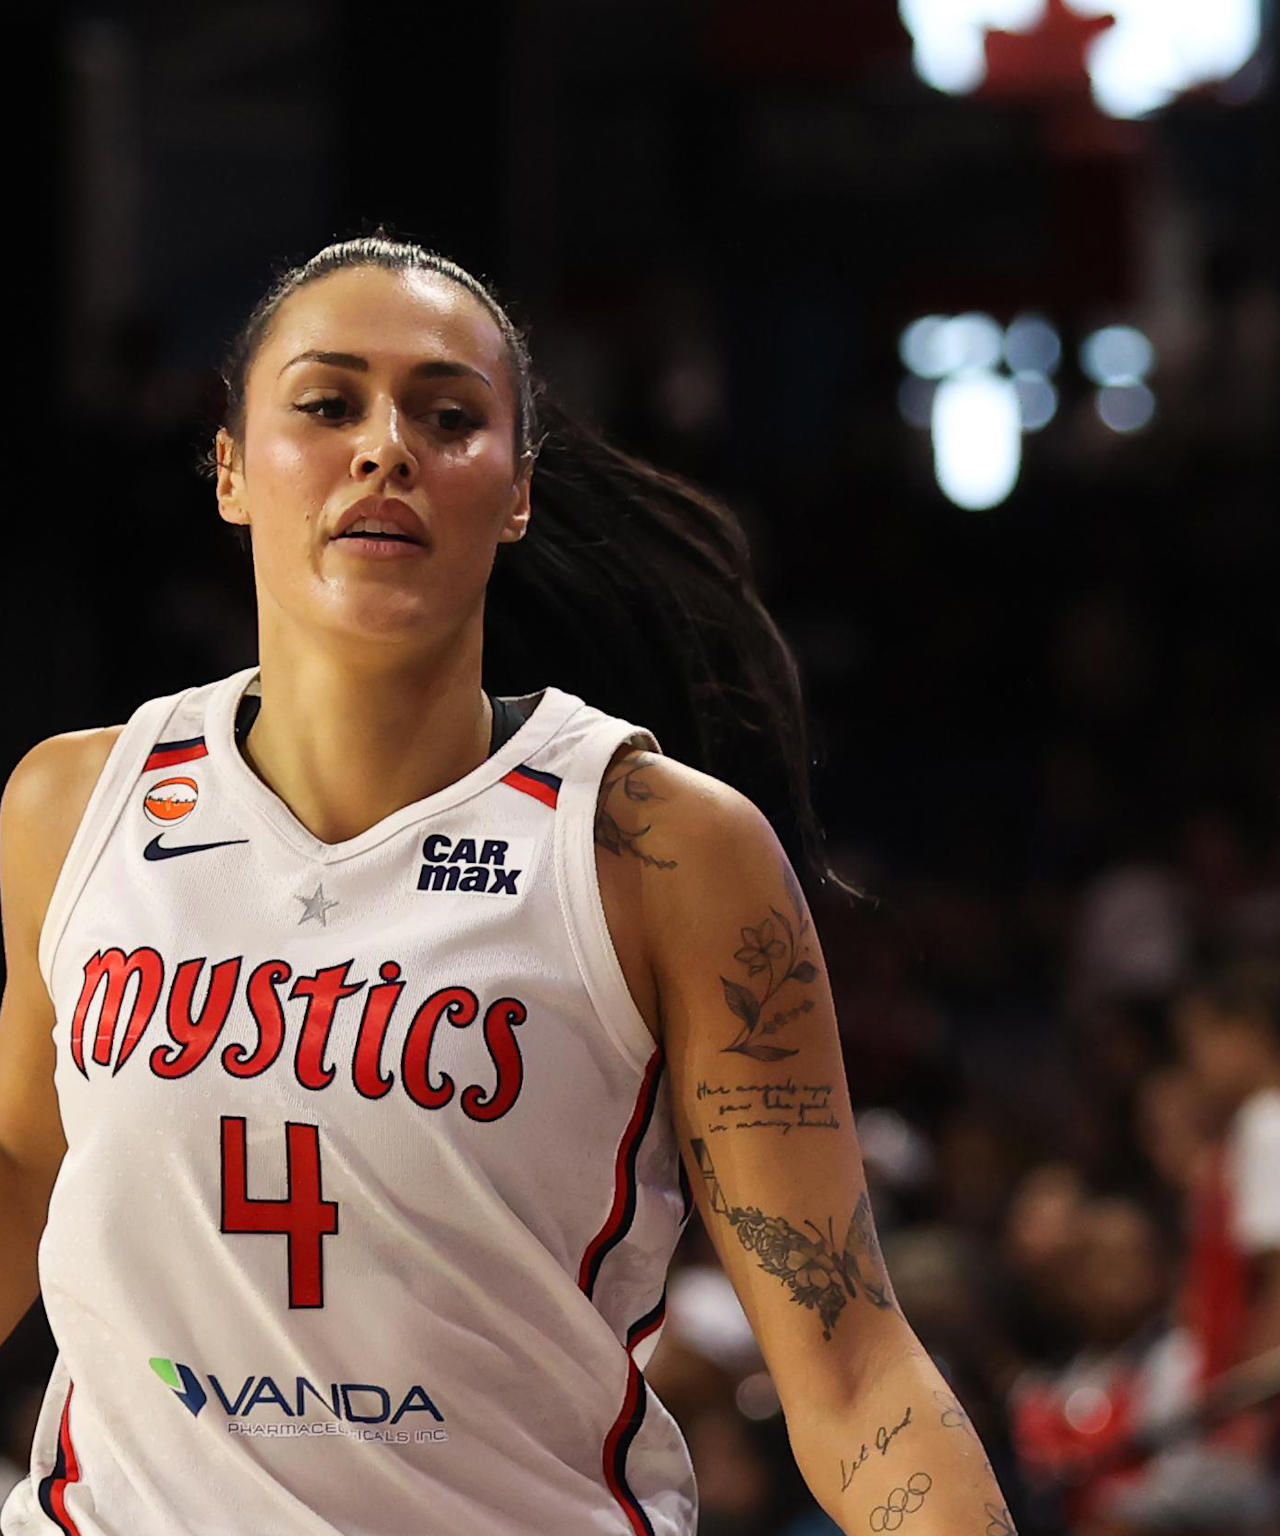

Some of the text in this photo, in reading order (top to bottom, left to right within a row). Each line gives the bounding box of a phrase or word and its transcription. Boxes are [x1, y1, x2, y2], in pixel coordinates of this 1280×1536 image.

[423, 834, 509, 866] CAR
[417, 864, 522, 895] max
[220, 1115, 338, 1309] 4
[206, 1373, 445, 1425] VANDA
